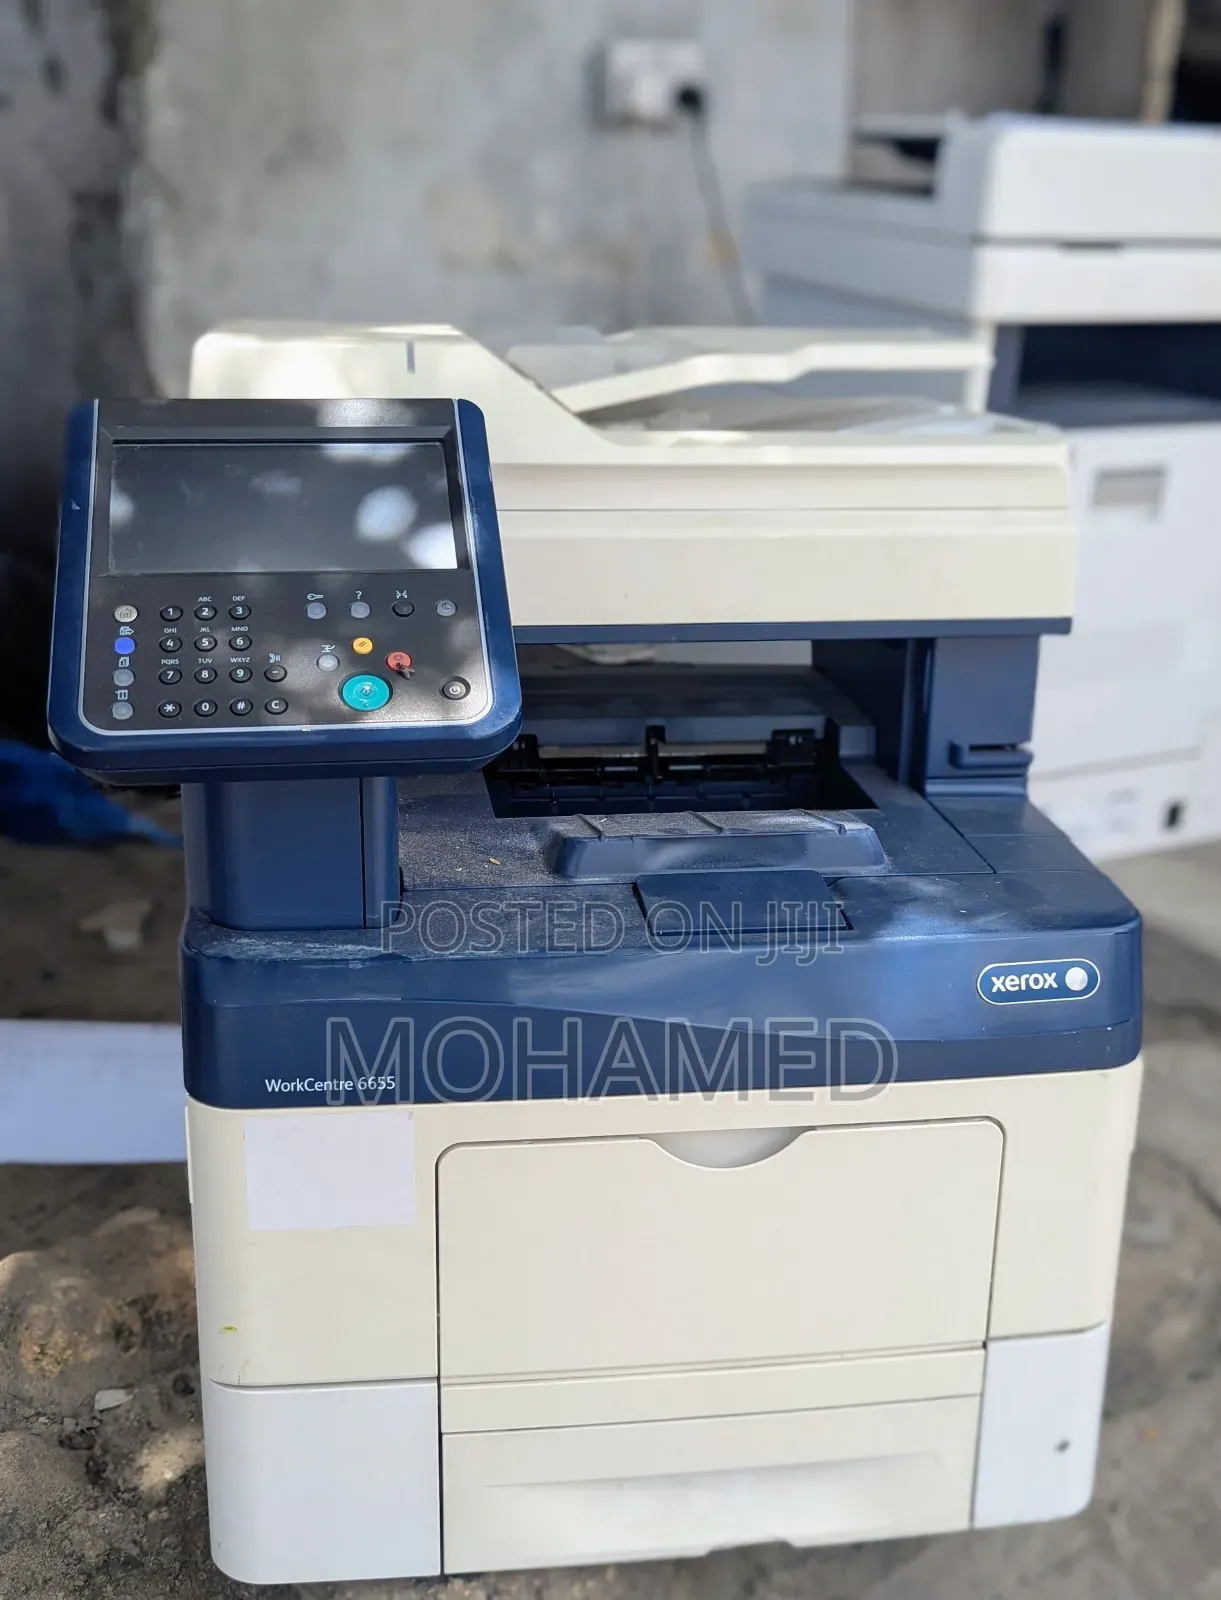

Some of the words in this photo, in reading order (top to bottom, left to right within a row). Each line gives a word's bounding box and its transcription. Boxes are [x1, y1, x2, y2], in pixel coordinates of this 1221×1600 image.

[167, 608, 173, 616] 1
[202, 608, 208, 616] 2
[236, 607, 243, 615] 3
[166, 639, 173, 647] 4
[202, 638, 208, 646] 5
[236, 637, 243, 645] 6
[166, 671, 173, 679] 7
[202, 670, 208, 678] 8
[237, 669, 243, 677] 9
[202, 703, 209, 711] 0
[237, 701, 245, 710] #
[272, 701, 279, 709] C
[991, 971, 1058, 993] xerox
[265, 1077, 354, 1093] WorkCentre
[358, 1075, 396, 1092] 6655
